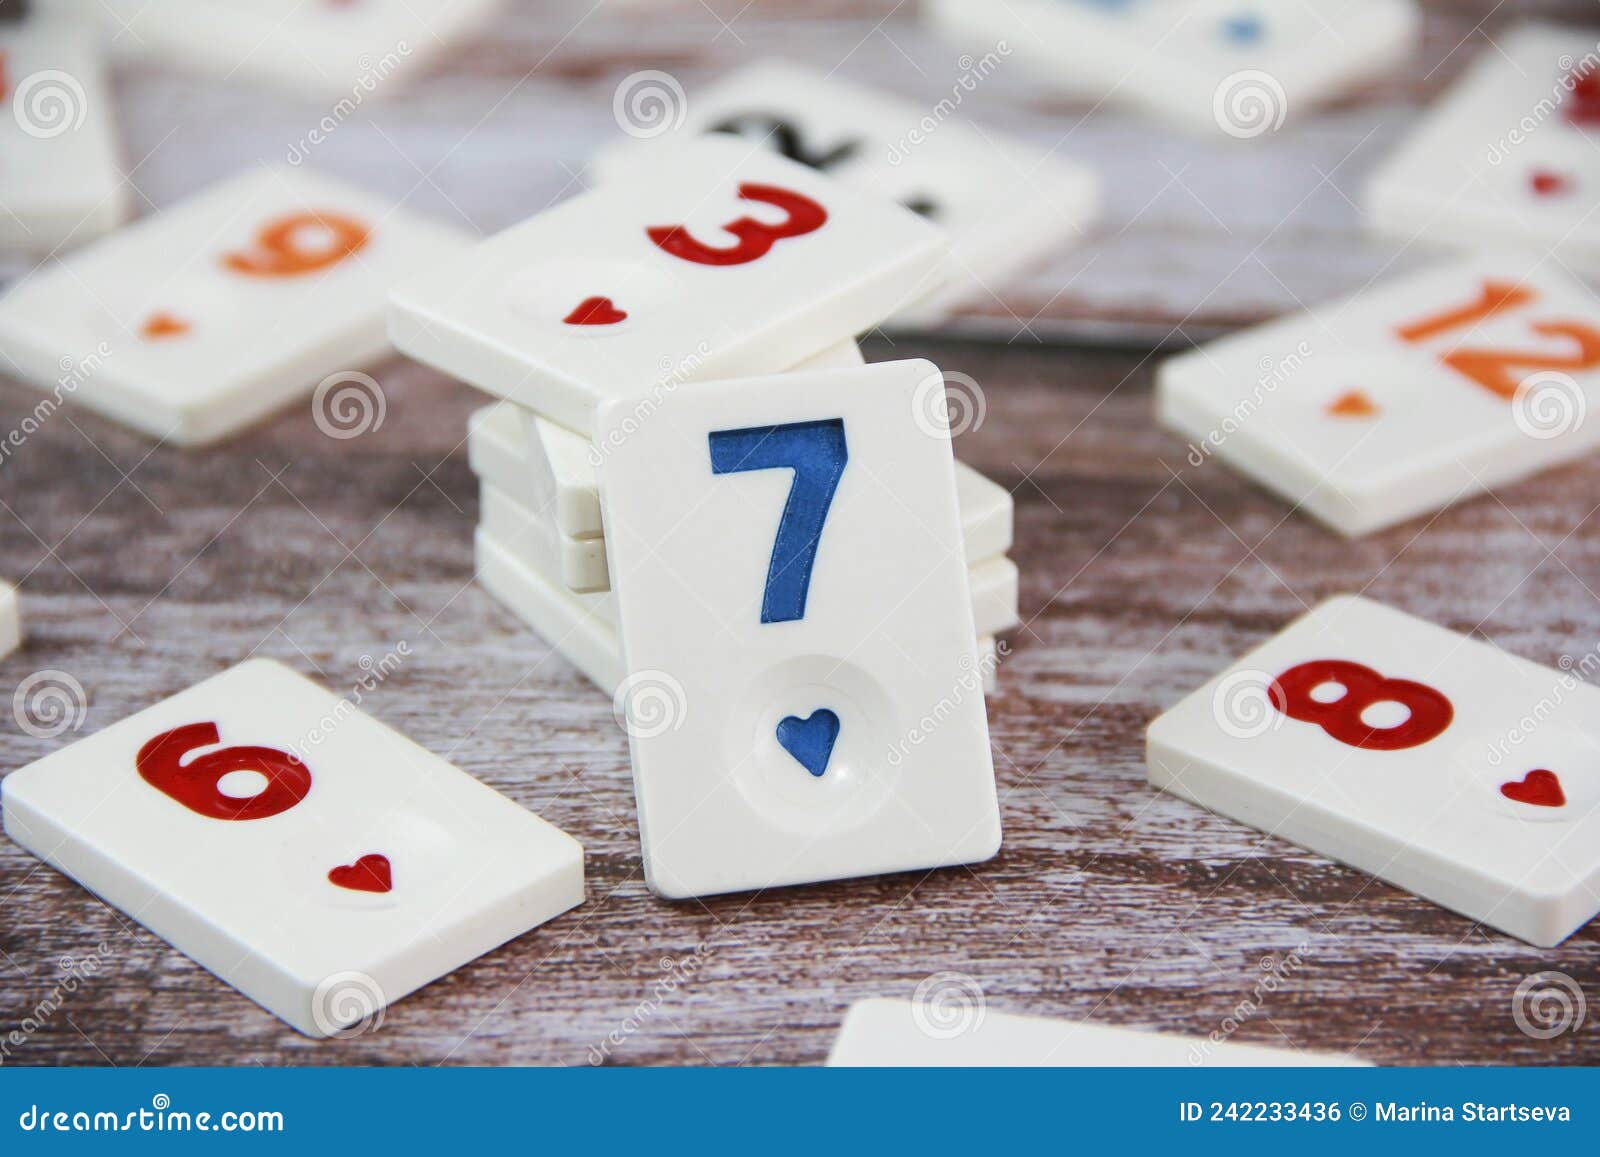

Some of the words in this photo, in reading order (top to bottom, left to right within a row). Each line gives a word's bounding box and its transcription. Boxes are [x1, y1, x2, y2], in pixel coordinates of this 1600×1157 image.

[221, 211, 372, 280] 9
[646, 182, 829, 267] 3
[708, 418, 849, 625] 7
[1267, 659, 1455, 751] 8
[135, 721, 313, 822] 6
